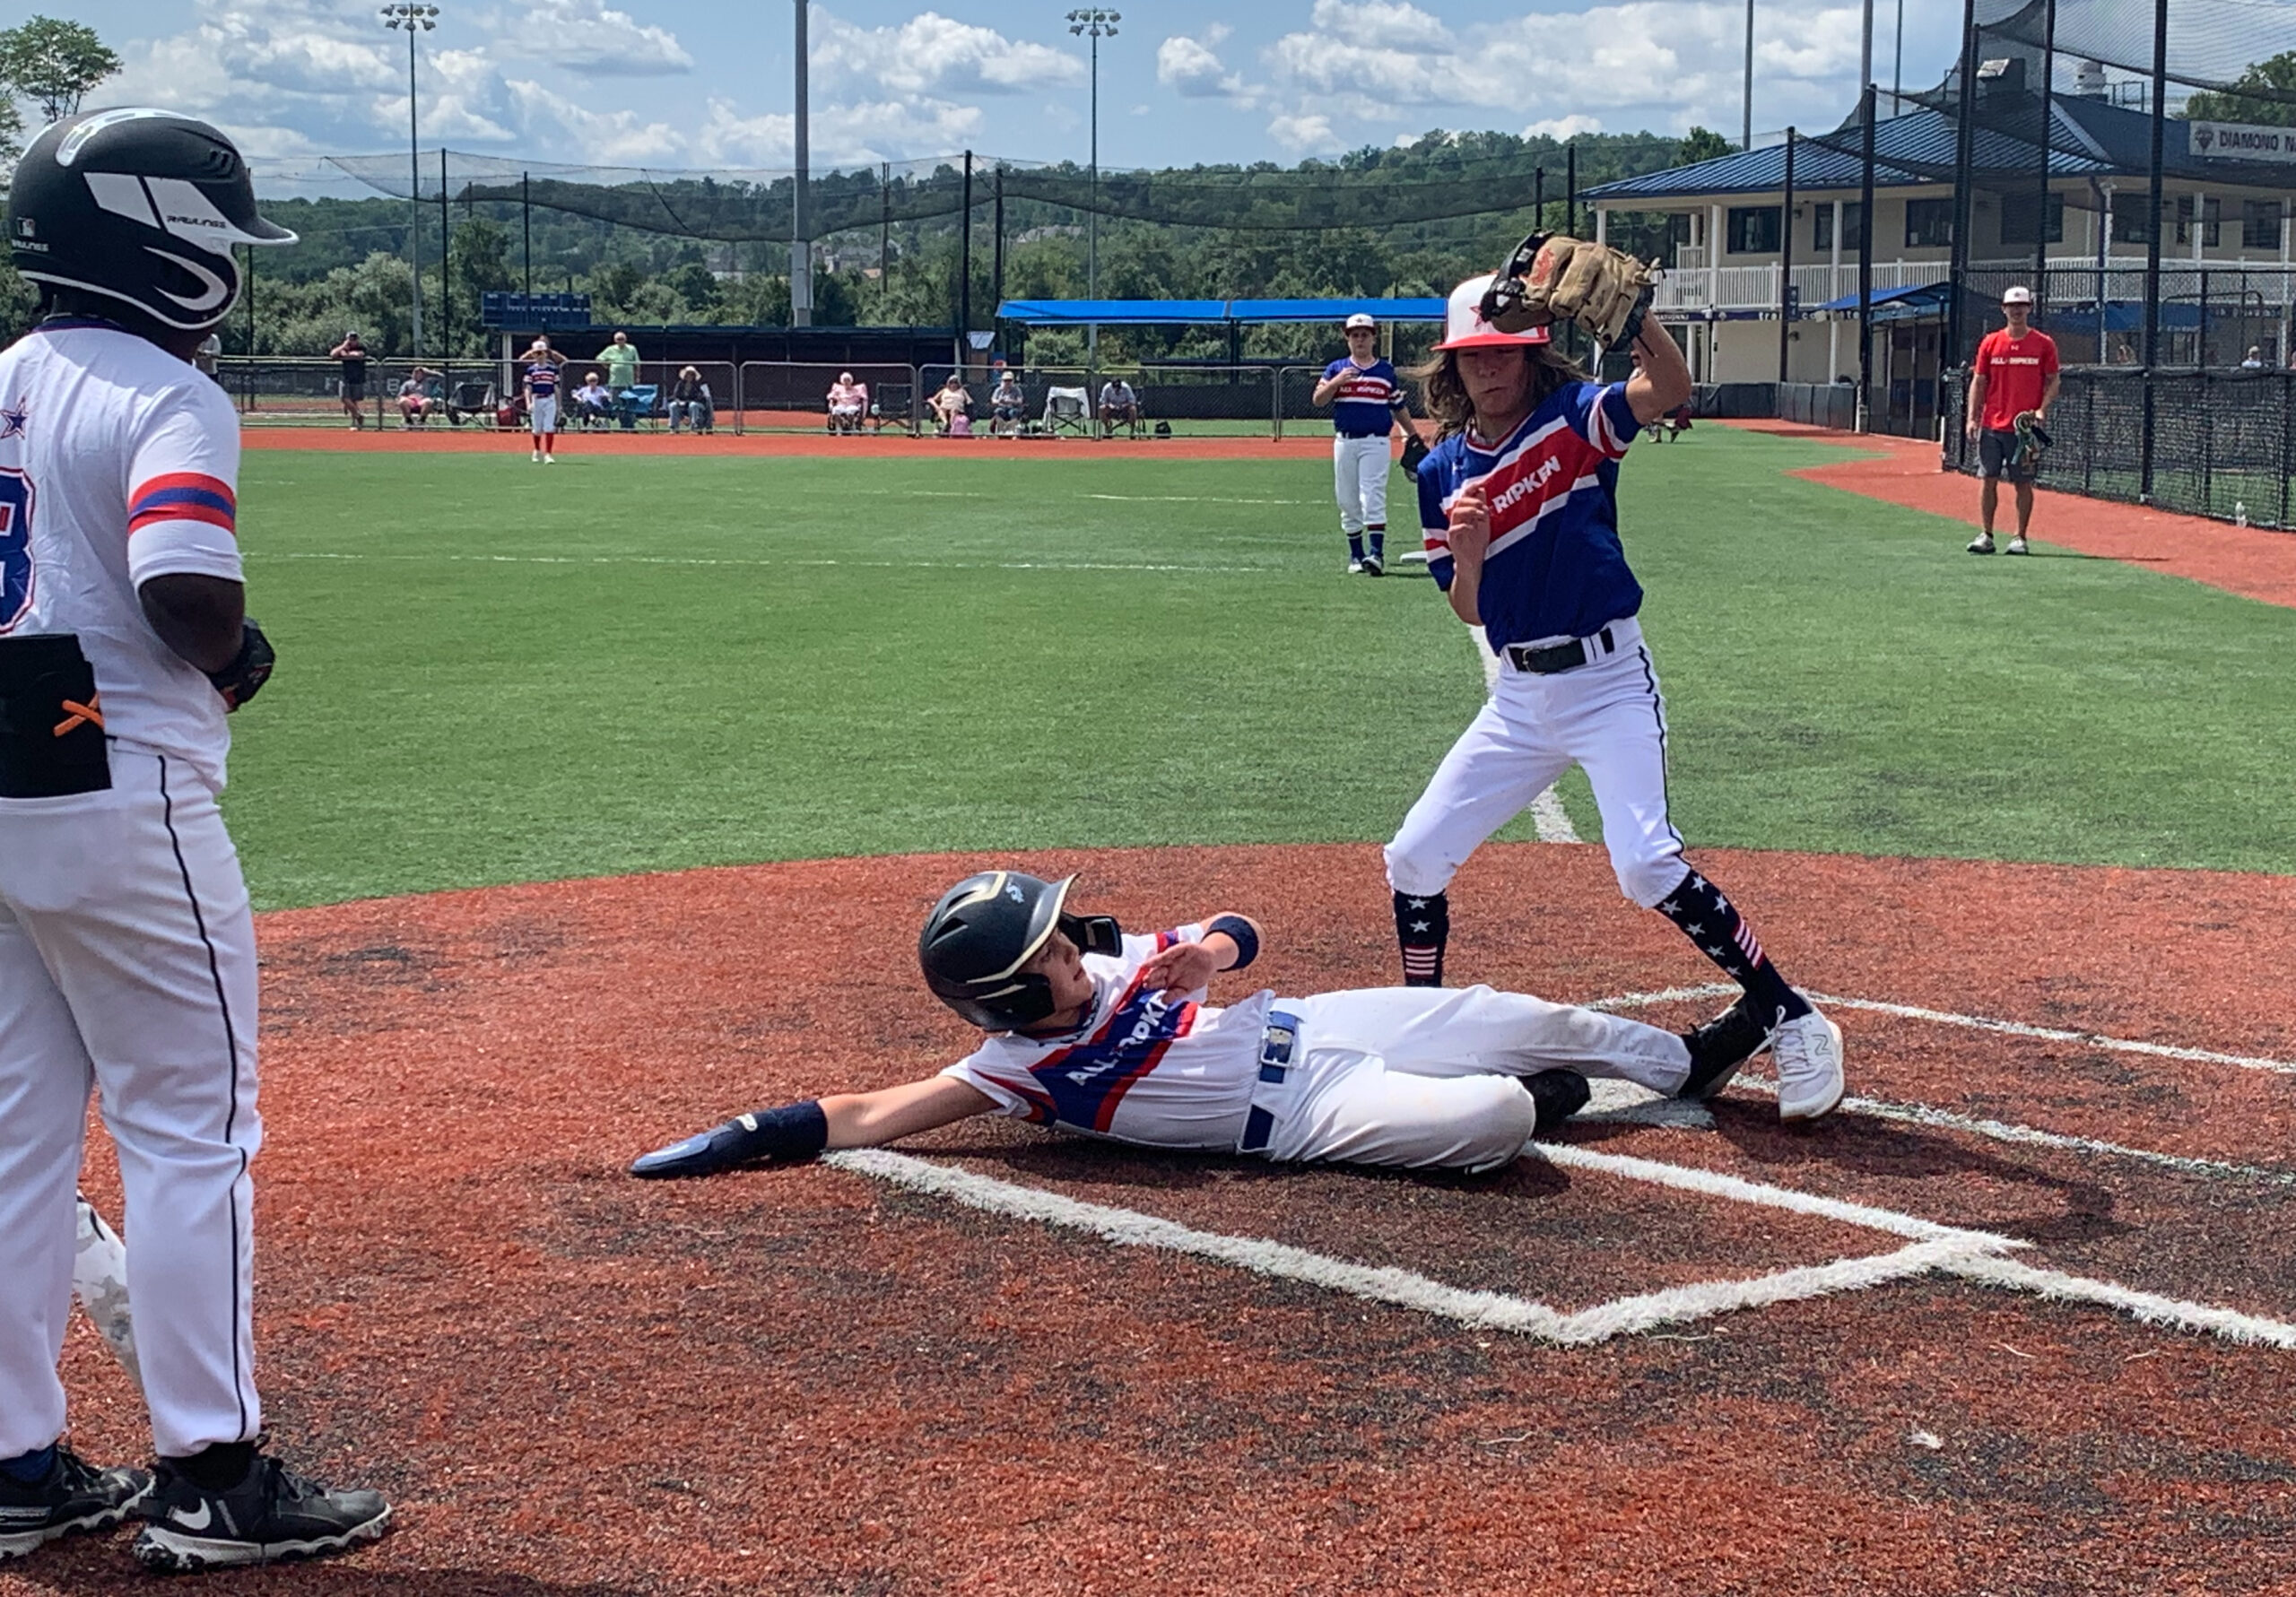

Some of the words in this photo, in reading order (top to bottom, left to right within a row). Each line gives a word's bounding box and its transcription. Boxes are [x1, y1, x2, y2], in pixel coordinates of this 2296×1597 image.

[2219, 130, 2279, 152] DIAMOND
[1491, 455, 1561, 514] RIPKEN
[1065, 1058, 1120, 1086] ALL
